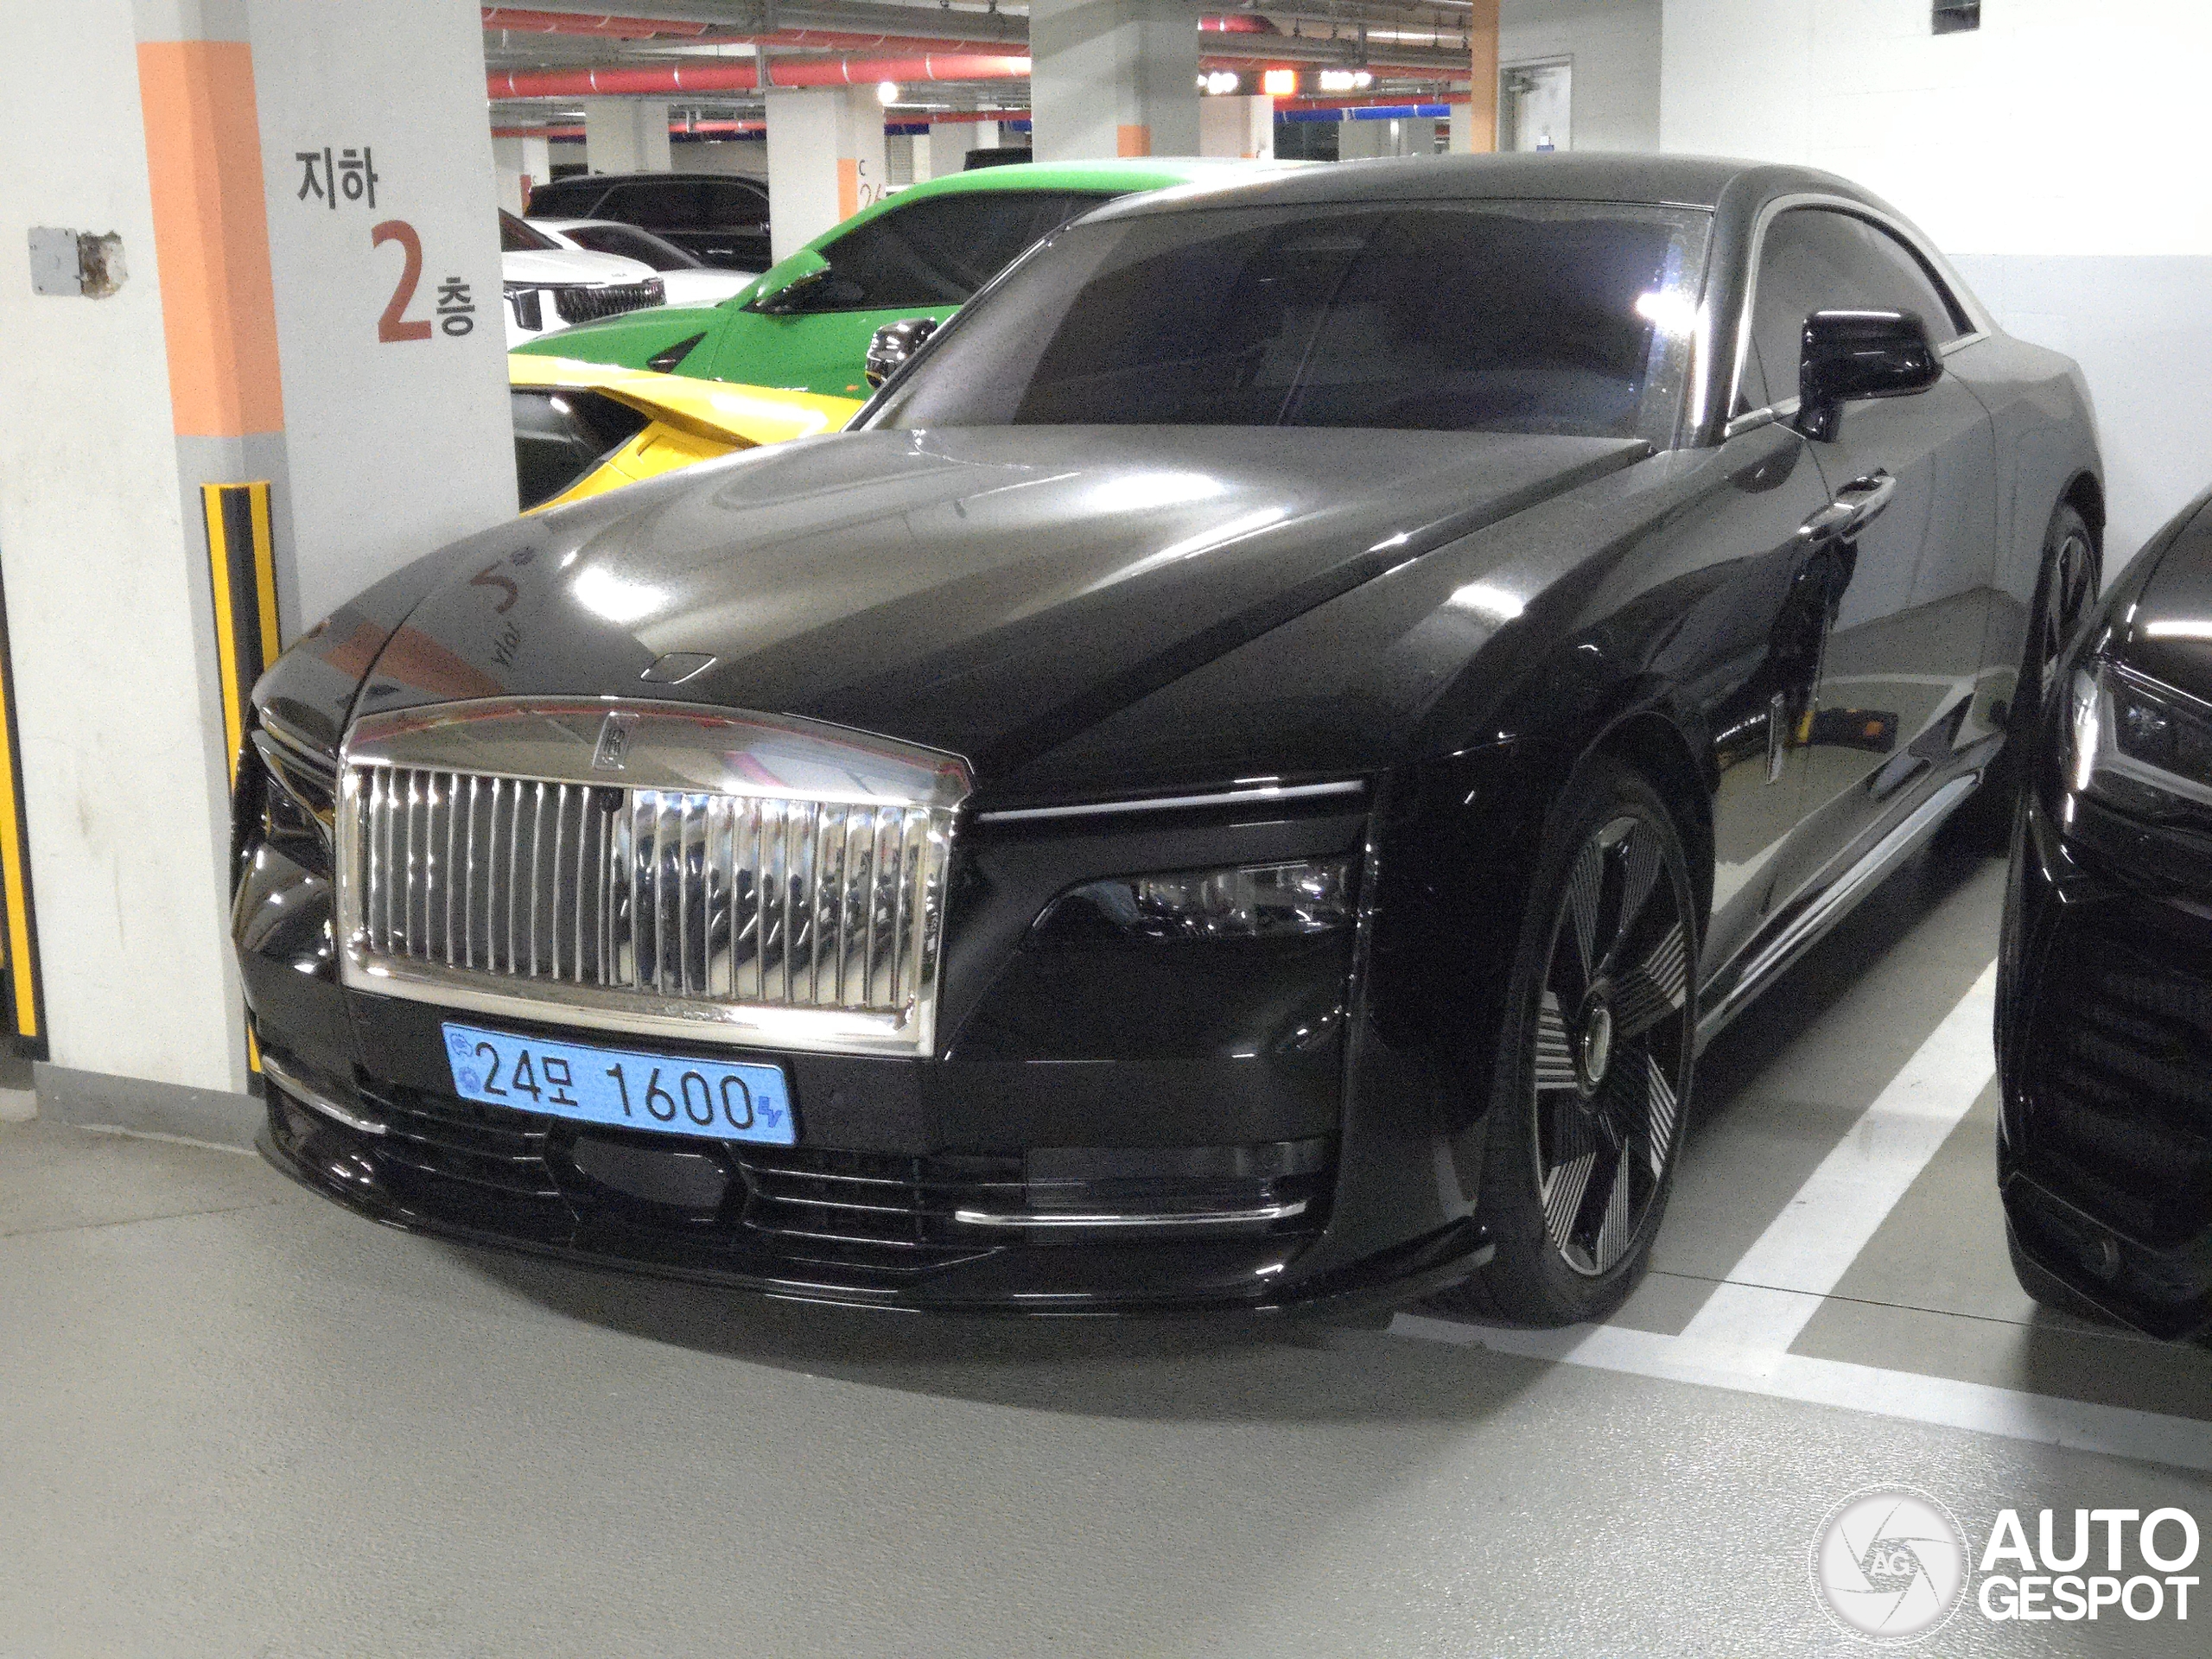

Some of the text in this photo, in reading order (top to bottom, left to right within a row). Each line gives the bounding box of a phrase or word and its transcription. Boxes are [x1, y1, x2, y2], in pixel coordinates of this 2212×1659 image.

[295, 145, 378, 210] 지하
[858, 159, 866, 176] C
[474, 1041, 754, 1130] 24모 1600
